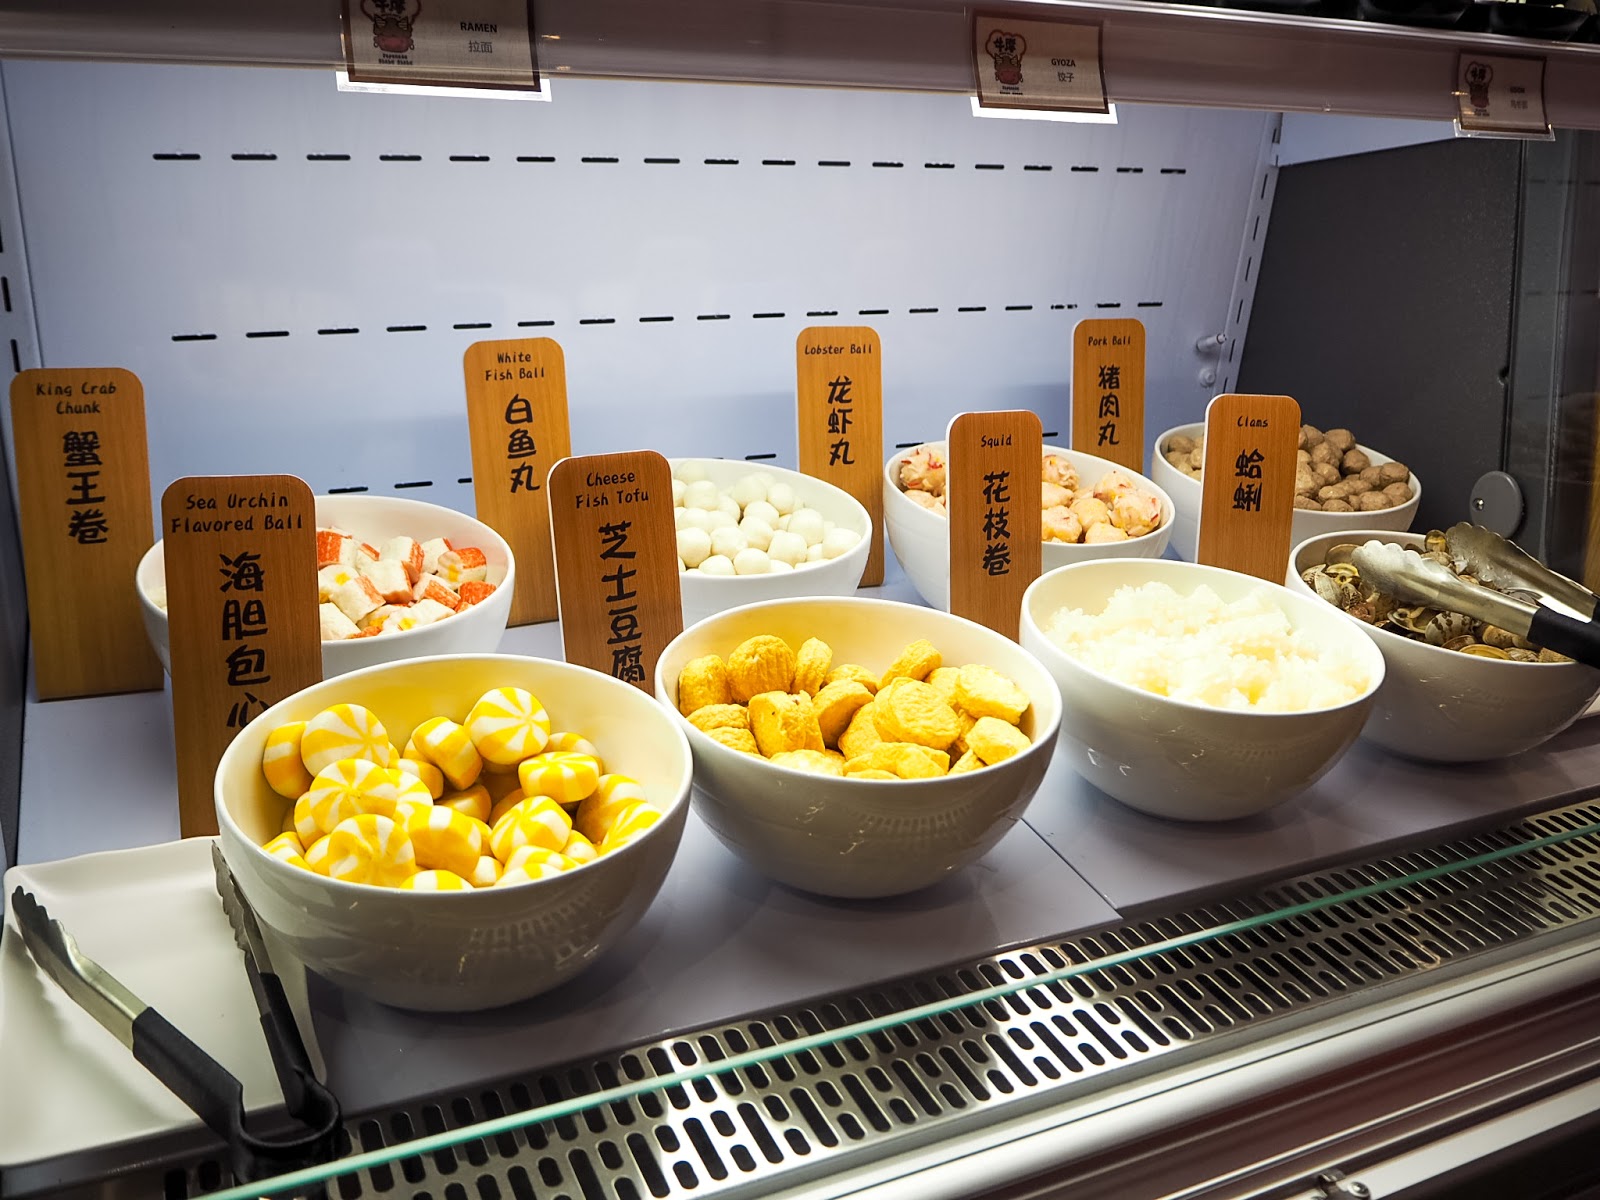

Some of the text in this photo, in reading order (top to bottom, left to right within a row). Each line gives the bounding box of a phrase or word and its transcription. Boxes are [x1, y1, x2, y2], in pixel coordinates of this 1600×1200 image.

[459, 20, 498, 33] RAMEN
[468, 39, 493, 54] 拉面
[1050, 57, 1076, 67] GYOZA
[1057, 71, 1075, 83] 饺子
[804, 343, 872, 355] Lobster Ball
[1087, 335, 1131, 347] Pork Ball
[497, 351, 531, 364] White
[485, 367, 545, 382] Fish Ball
[36, 381, 117, 397] King Crab
[55, 400, 101, 415] Chunk
[1097, 364, 1121, 447] 猪肉丸
[827, 375, 855, 467] 龙虾丸
[1237, 415, 1269, 428] Clams
[504, 393, 541, 494] 白鱼丸
[980, 433, 1012, 449] Squid
[62, 430, 109, 545] 蟹王卷
[586, 471, 635, 488] Cheese
[1232, 448, 1265, 512] 蛤蜊
[185, 492, 288, 510] Sea Urchin
[575, 487, 649, 509] Fish Tofu
[171, 514, 302, 534] Flavored Ball
[982, 470, 1012, 577] 花枝卷
[597, 520, 646, 683] 芝士豆腐
[218, 551, 271, 728] 海胆包心
